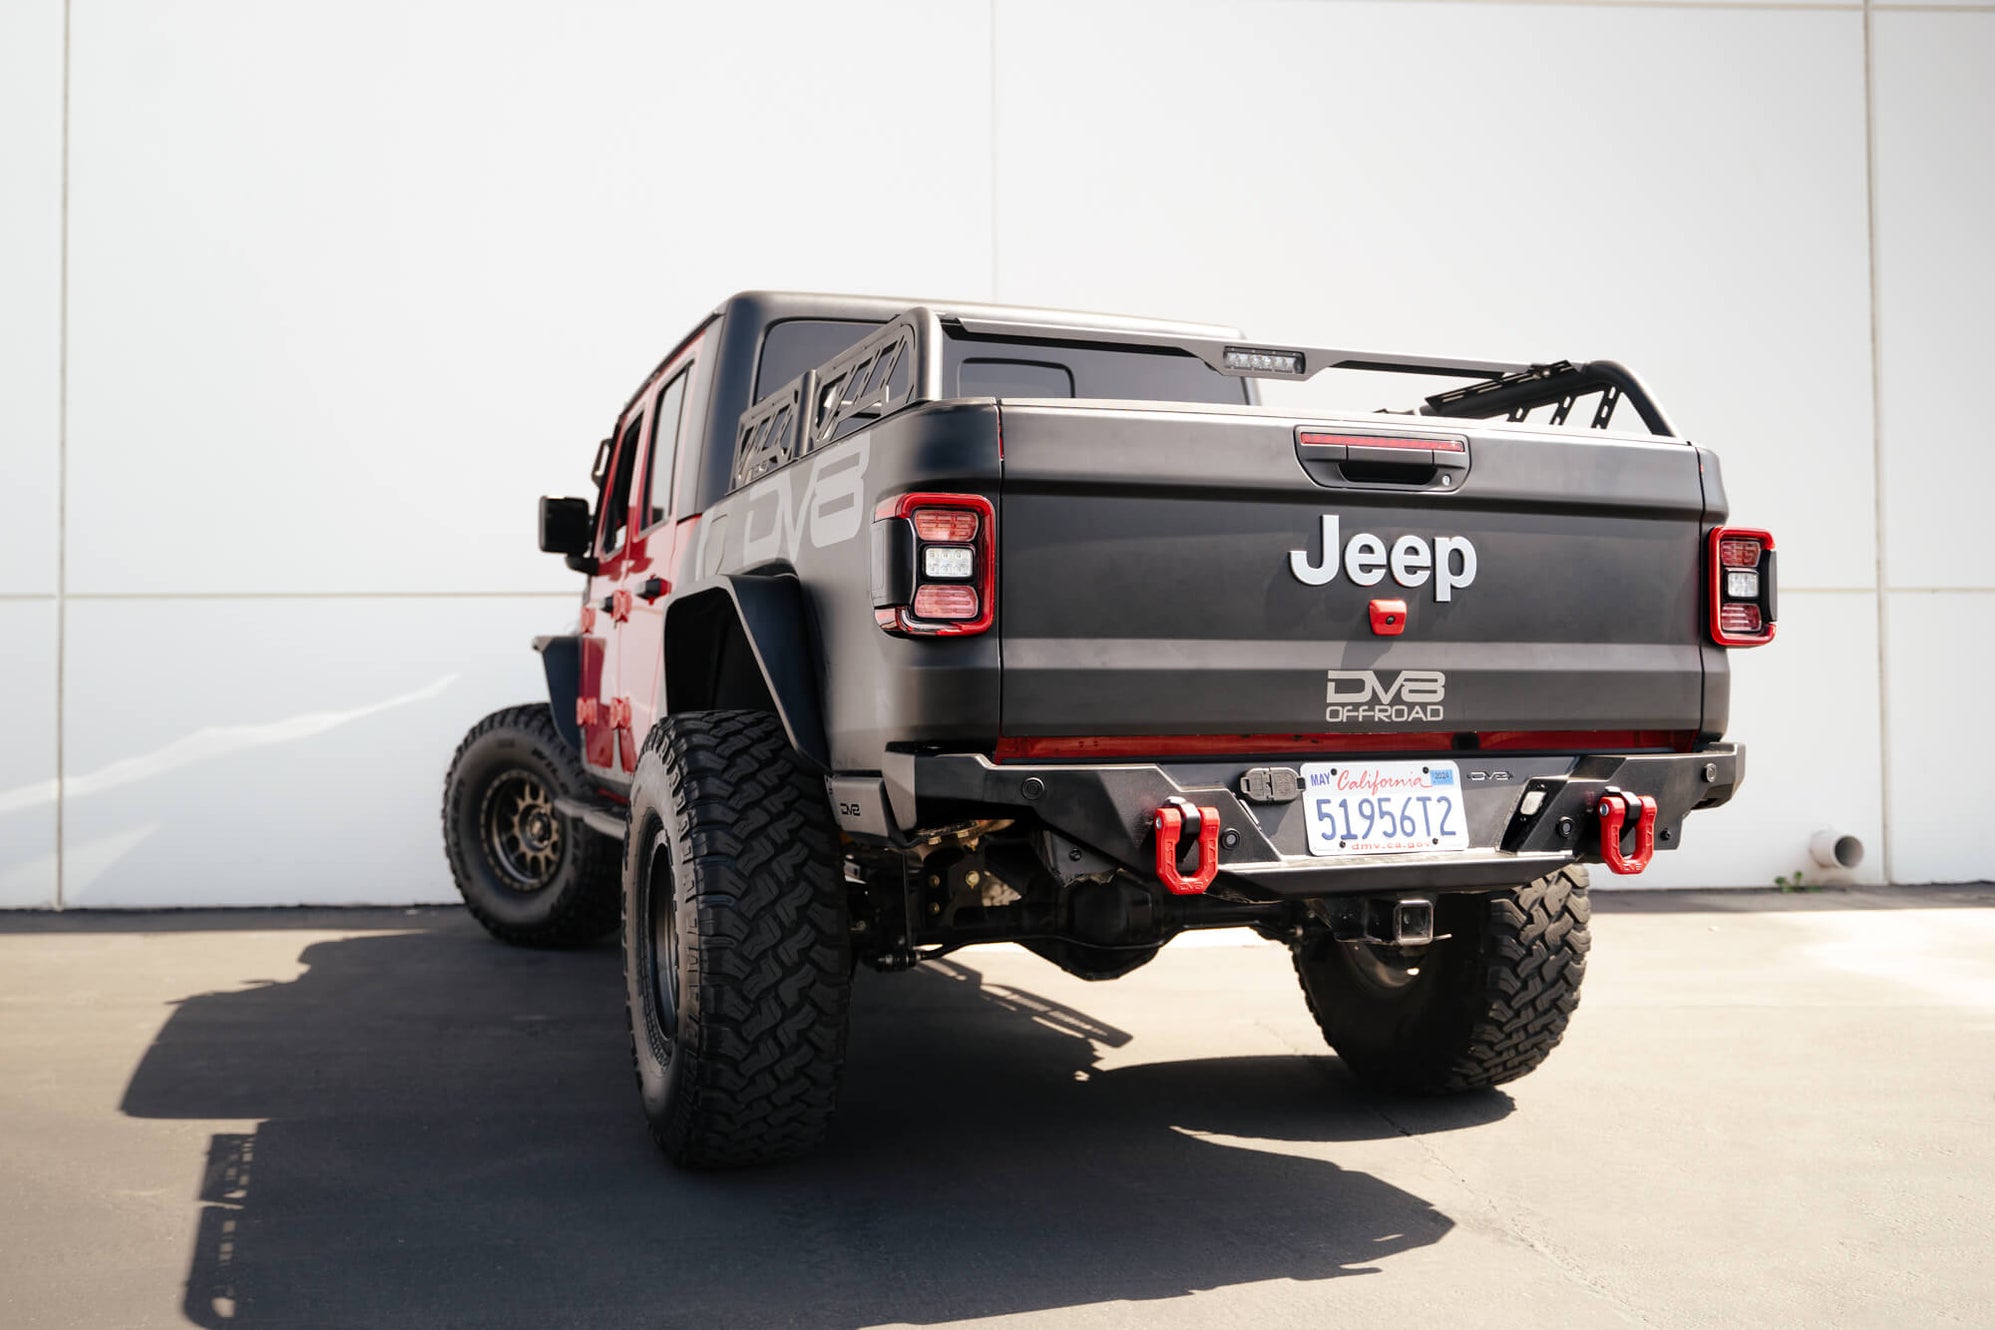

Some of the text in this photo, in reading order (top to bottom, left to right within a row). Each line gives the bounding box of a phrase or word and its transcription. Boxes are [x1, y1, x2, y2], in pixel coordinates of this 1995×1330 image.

[743, 431, 871, 567] DV8
[1289, 514, 1477, 602] Jeep
[1326, 670, 1446, 704] DV8
[1310, 772, 1331, 787] MAY
[1337, 769, 1433, 796] California
[1469, 770, 1511, 781] DV8
[840, 802, 861, 817] DV8
[1316, 795, 1457, 841] 51956T2
[1351, 840, 1431, 850] dmv.ca.gov
